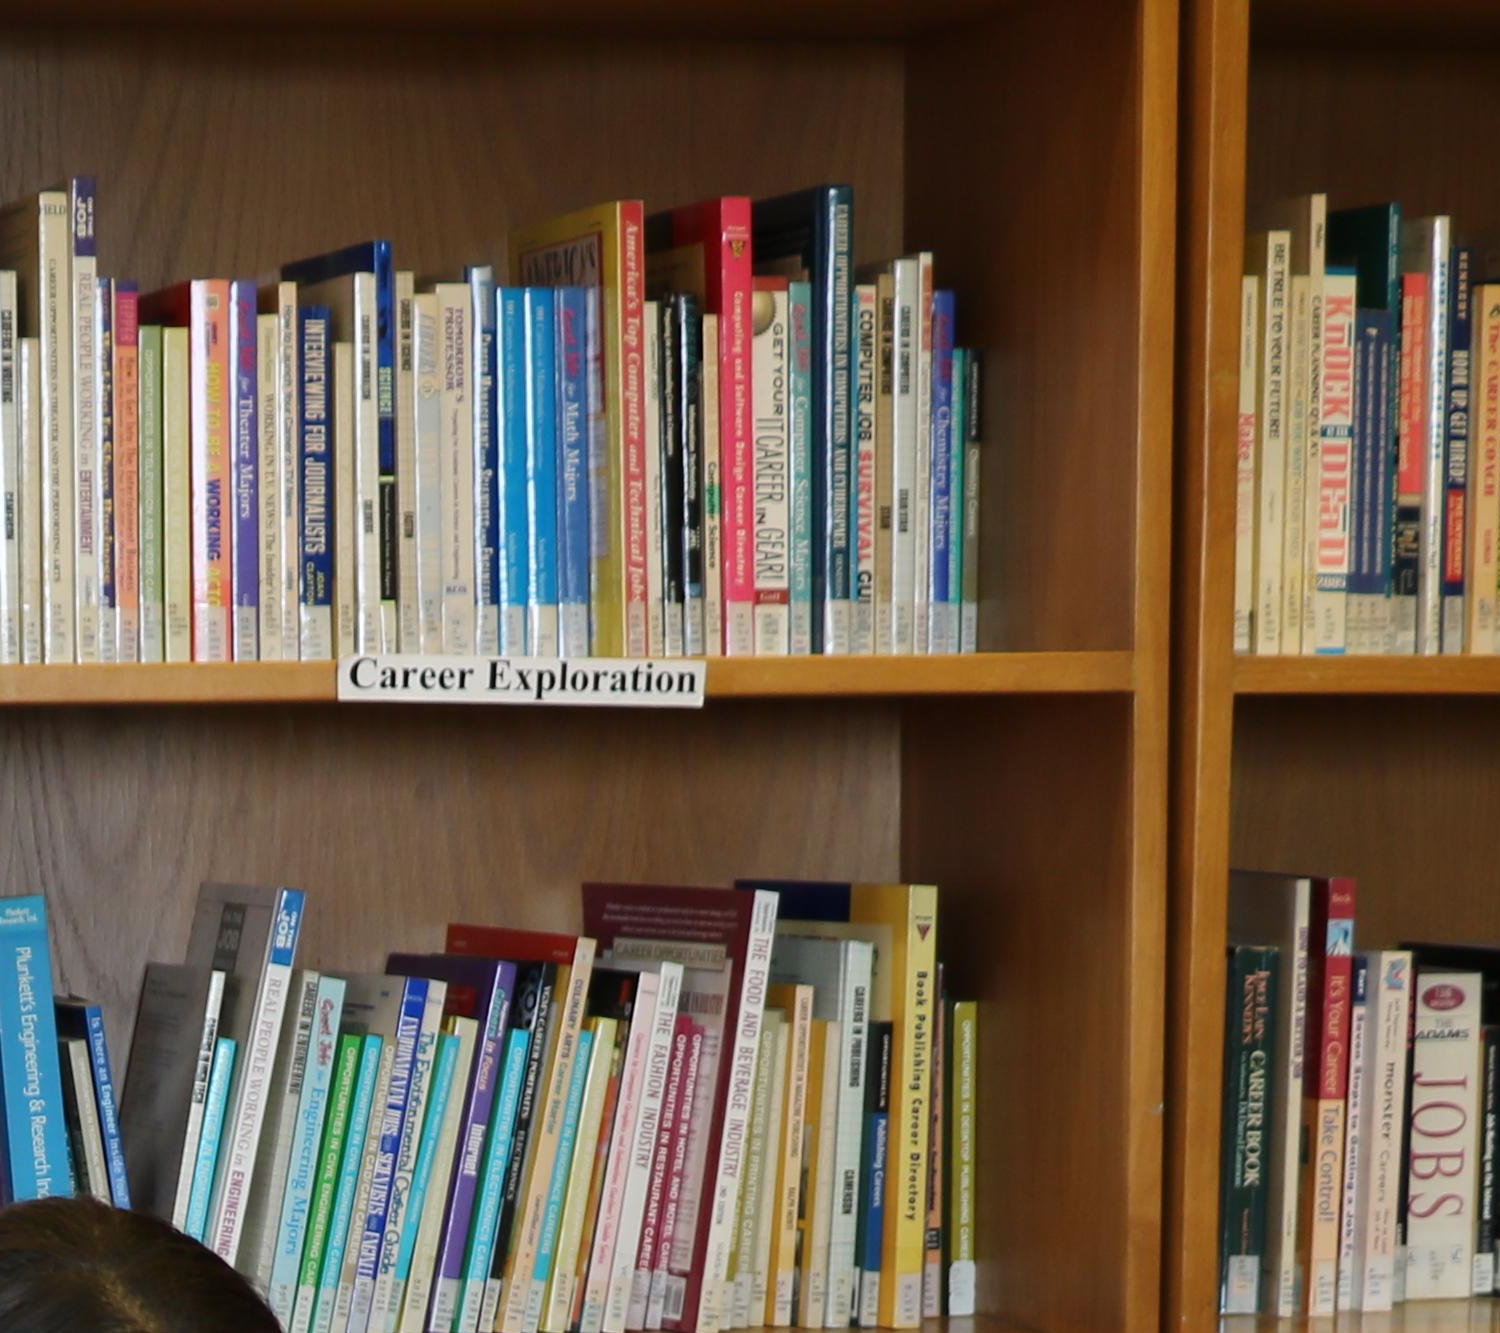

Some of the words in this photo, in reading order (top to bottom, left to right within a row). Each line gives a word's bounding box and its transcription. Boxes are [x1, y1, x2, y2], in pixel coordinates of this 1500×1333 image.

[623, 221, 641, 308] America's
[1457, 251, 1469, 321] KENNEDY
[624, 315, 642, 346] Top
[304, 320, 326, 418] INTERVIEWING
[625, 352, 643, 438] Computer
[304, 424, 326, 452] FOR
[628, 444, 640, 472] and
[304, 457, 326, 553] JOURNALISTS
[626, 479, 644, 560] Technical
[626, 566, 645, 602] Jobs
[349, 658, 474, 690] Career
[488, 660, 696, 700] Exploration
[751, 938, 769, 960] THE
[260, 979, 283, 1016] REAL
[745, 970, 765, 1004] FOOD
[250, 1021, 275, 1072] PEOPLE
[656, 1011, 677, 1034] THE
[740, 1012, 760, 1037] AND
[1415, 1027, 1470, 1041] ADAMS
[645, 1044, 671, 1095] FASHION
[731, 1046, 755, 1109] BEVERAGE
[236, 1079, 265, 1150] WORKING
[632, 1107, 660, 1167] INDUSTRY
[1322, 1105, 1340, 1144] Take
[233, 1153, 251, 1166] in
[463, 1123, 486, 1177] Internet
[722, 1118, 746, 1177] INDUSTRY
[1410, 1072, 1468, 1219] JOBS
[1317, 1150, 1337, 1220] Control!
[216, 1171, 248, 1257] ENGINEERING
